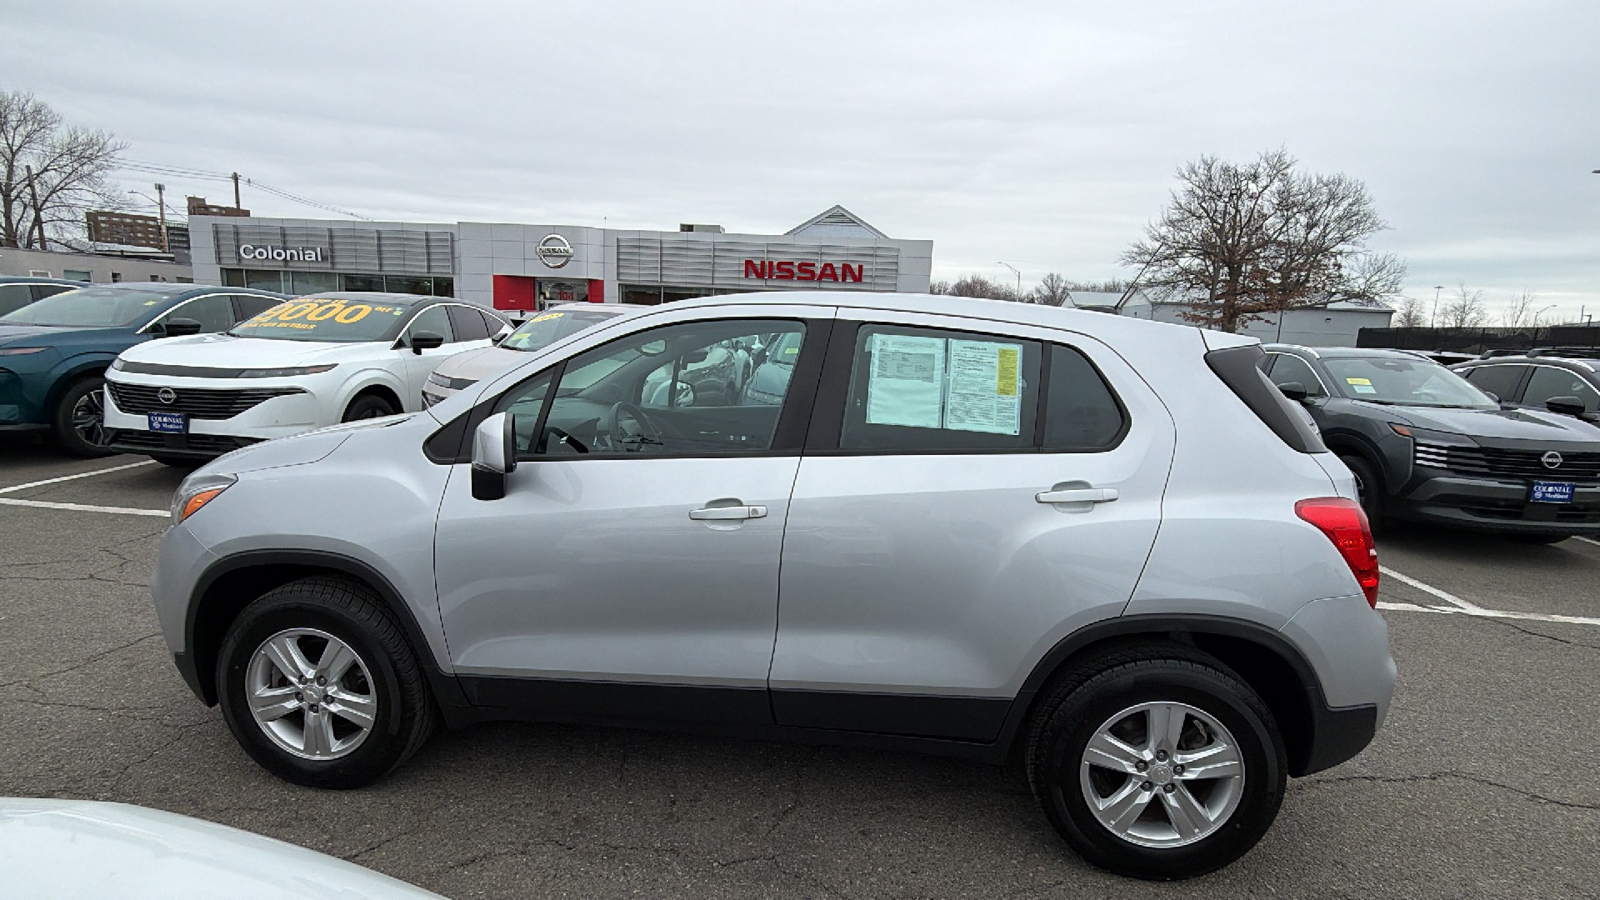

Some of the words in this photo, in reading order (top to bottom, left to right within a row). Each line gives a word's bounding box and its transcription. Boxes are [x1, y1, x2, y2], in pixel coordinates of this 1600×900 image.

[240, 244, 322, 262] Colonial
[744, 259, 864, 283] NISSAN
[151, 416, 184, 424] COLONIAL
